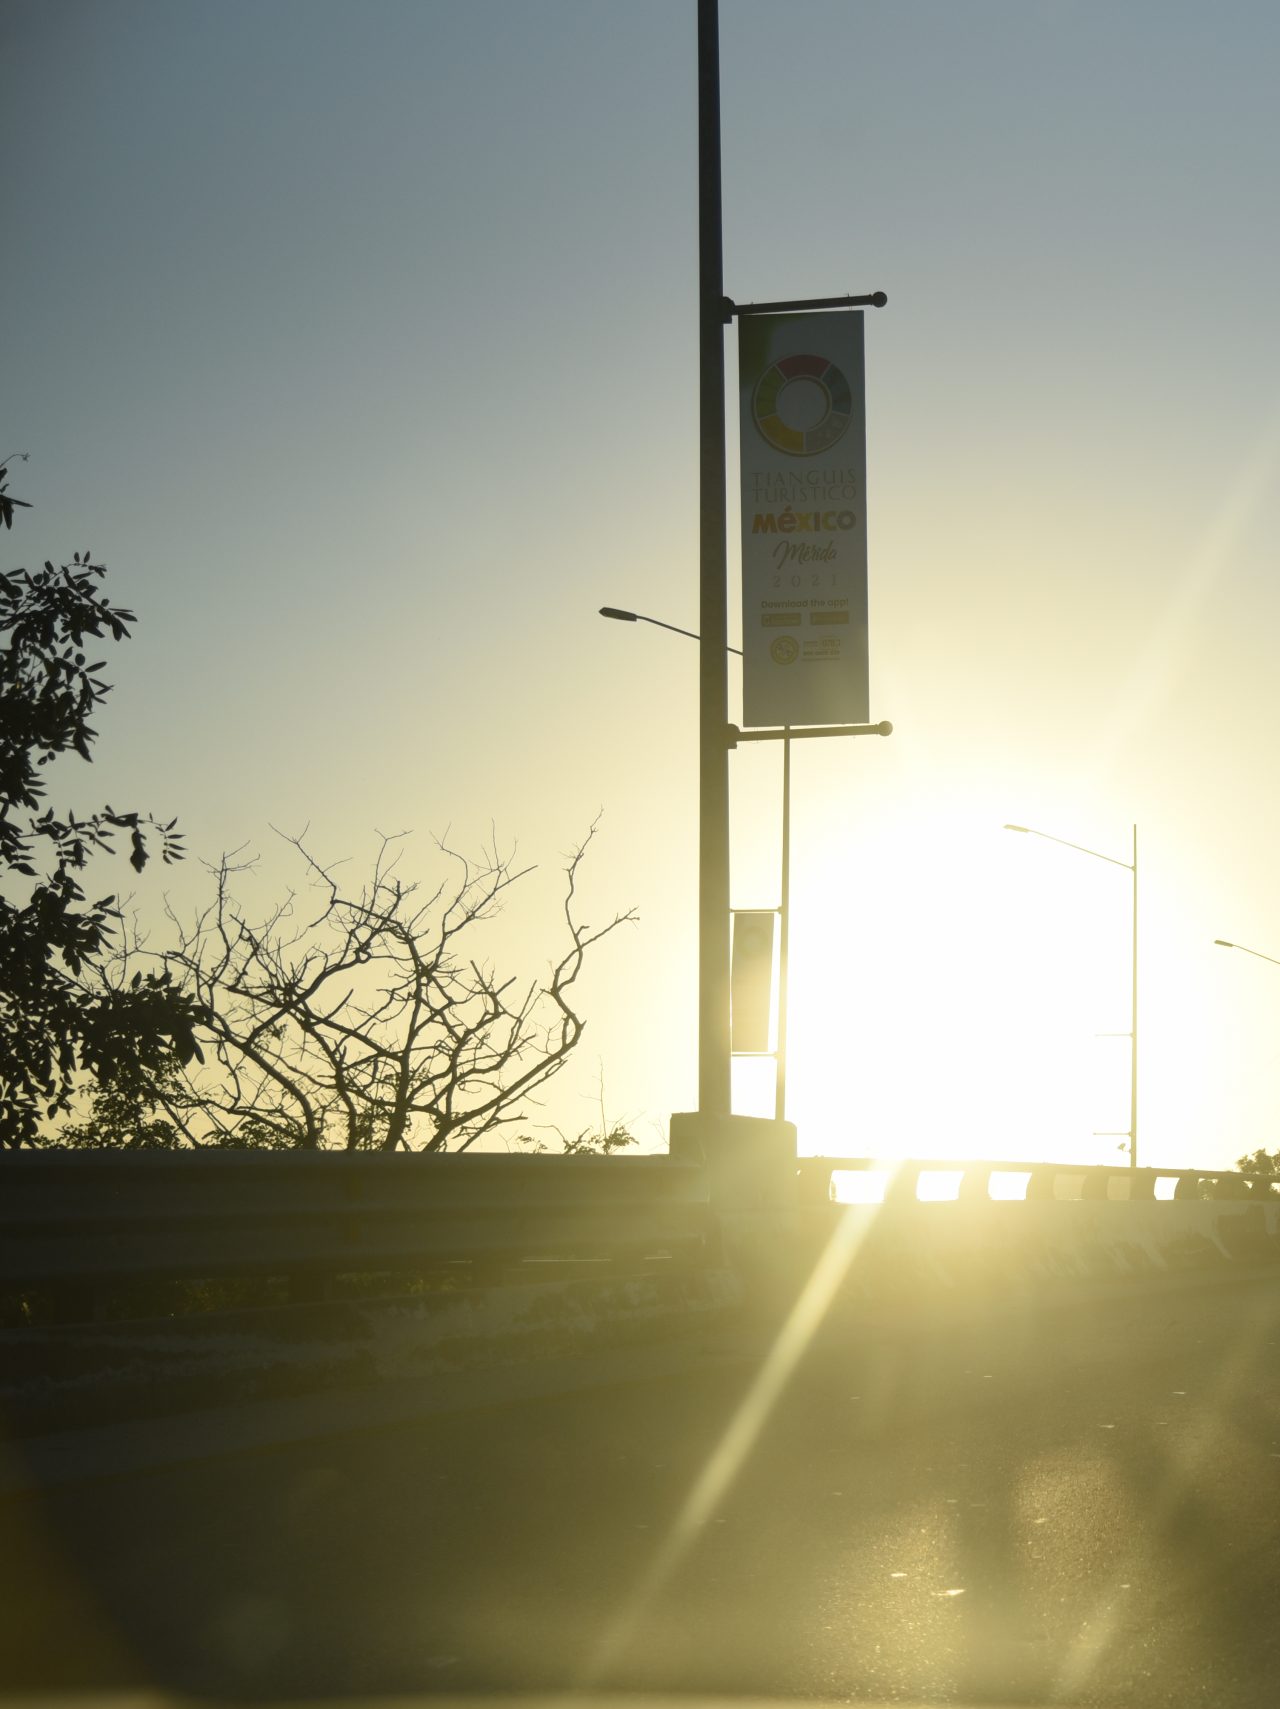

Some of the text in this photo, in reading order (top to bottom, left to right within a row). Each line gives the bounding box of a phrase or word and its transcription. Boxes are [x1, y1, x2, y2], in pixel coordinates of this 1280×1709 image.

[752, 468, 856, 488] TIANGUIS
[772, 539, 839, 570] Mérida
[761, 599, 808, 609] Download
[810, 598, 825, 607] the
